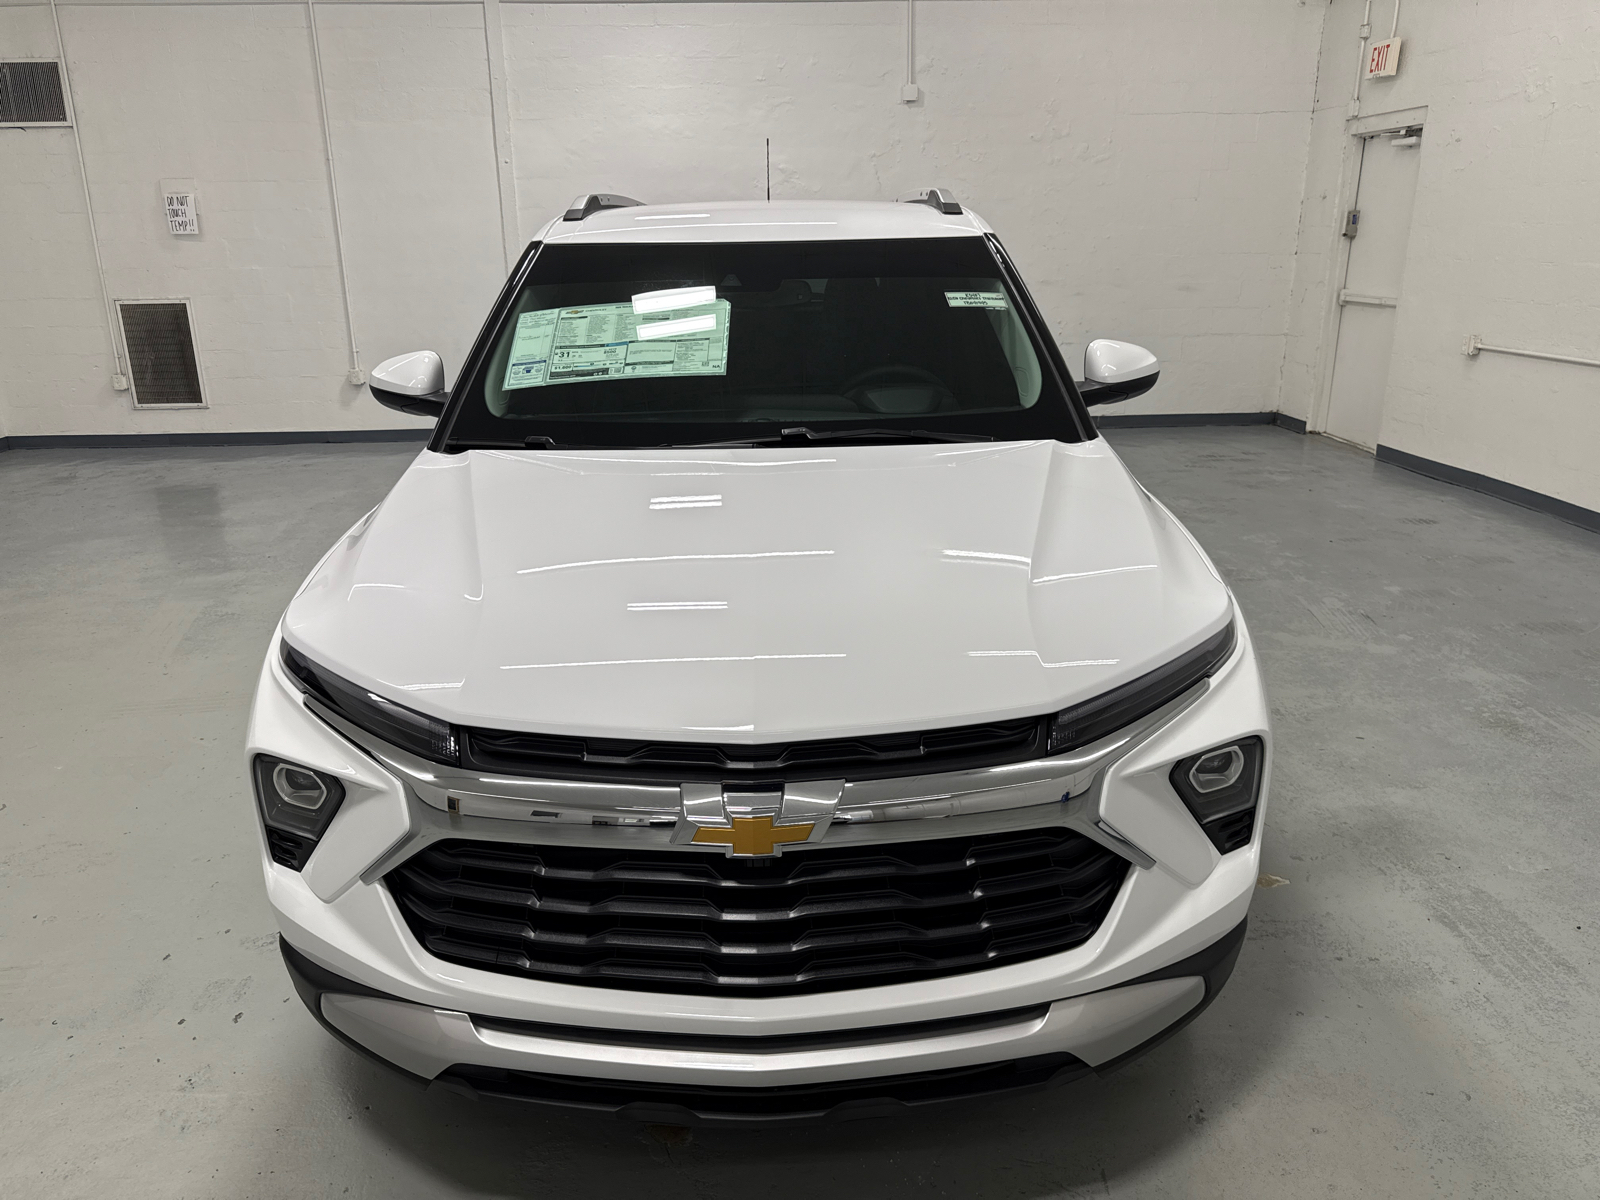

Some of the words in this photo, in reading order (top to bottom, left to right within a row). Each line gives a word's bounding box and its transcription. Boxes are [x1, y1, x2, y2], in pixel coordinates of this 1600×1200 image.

[1369, 43, 1391, 73] EXIT
[166, 196, 174, 207] DO
[176, 196, 190, 207] NOT
[167, 208, 187, 219] TOUCH
[169, 219, 195, 232] TEMP!!
[558, 351, 570, 359] 31
